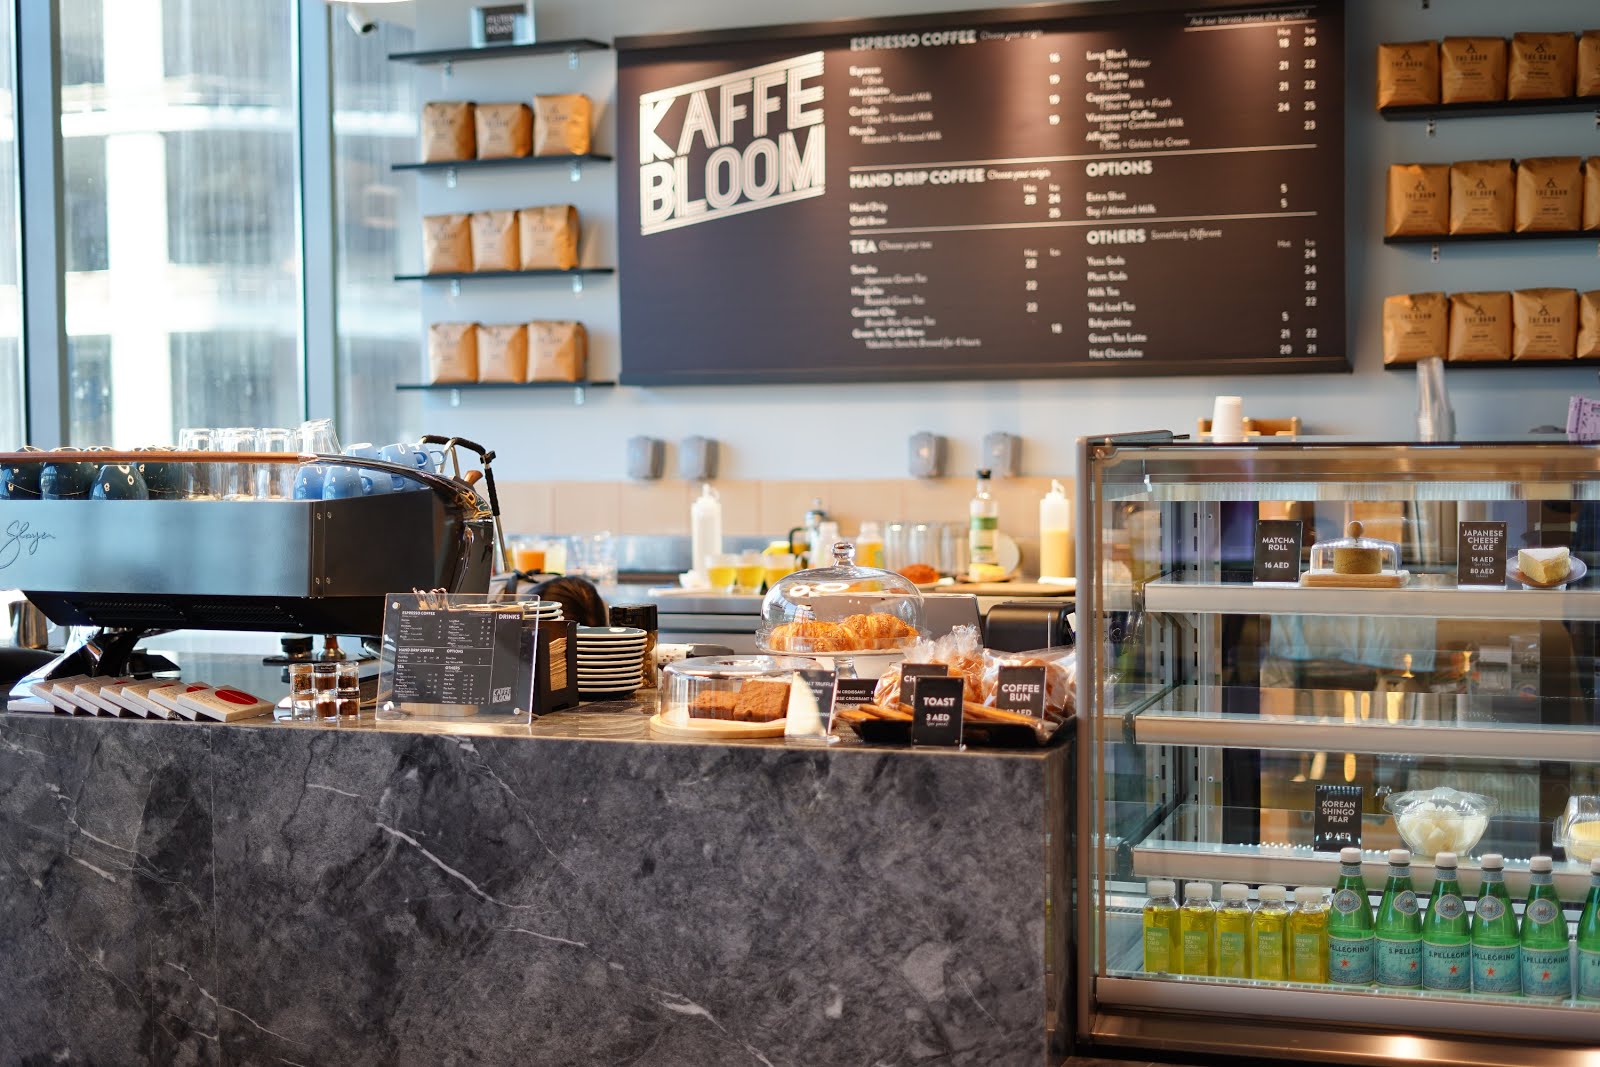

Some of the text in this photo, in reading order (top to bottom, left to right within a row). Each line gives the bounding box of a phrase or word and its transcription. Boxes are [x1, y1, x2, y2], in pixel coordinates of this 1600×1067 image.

[850, 34, 920, 51] ESPRESSO
[921, 29, 976, 47] COFFEE
[640, 56, 824, 164] KAFFE
[1086, 160, 1153, 177] OPTIONS
[640, 124, 825, 230] BLOOM
[850, 173, 892, 189] HAND
[893, 171, 929, 187] DRIP
[929, 168, 986, 185] COFFEE
[1086, 229, 1146, 245] OTHERS
[849, 239, 878, 254] TEA
[1463, 529, 1504, 537] JAPANESE
[1002, 684, 1040, 693] COFFEE
[923, 697, 956, 706] TOAST
[1010, 693, 1031, 702] BUN
[1322, 800, 1356, 808] KOREAN
[1322, 808, 1355, 816] SHINGO
[1328, 944, 1370, 954] PELLEGRINO
